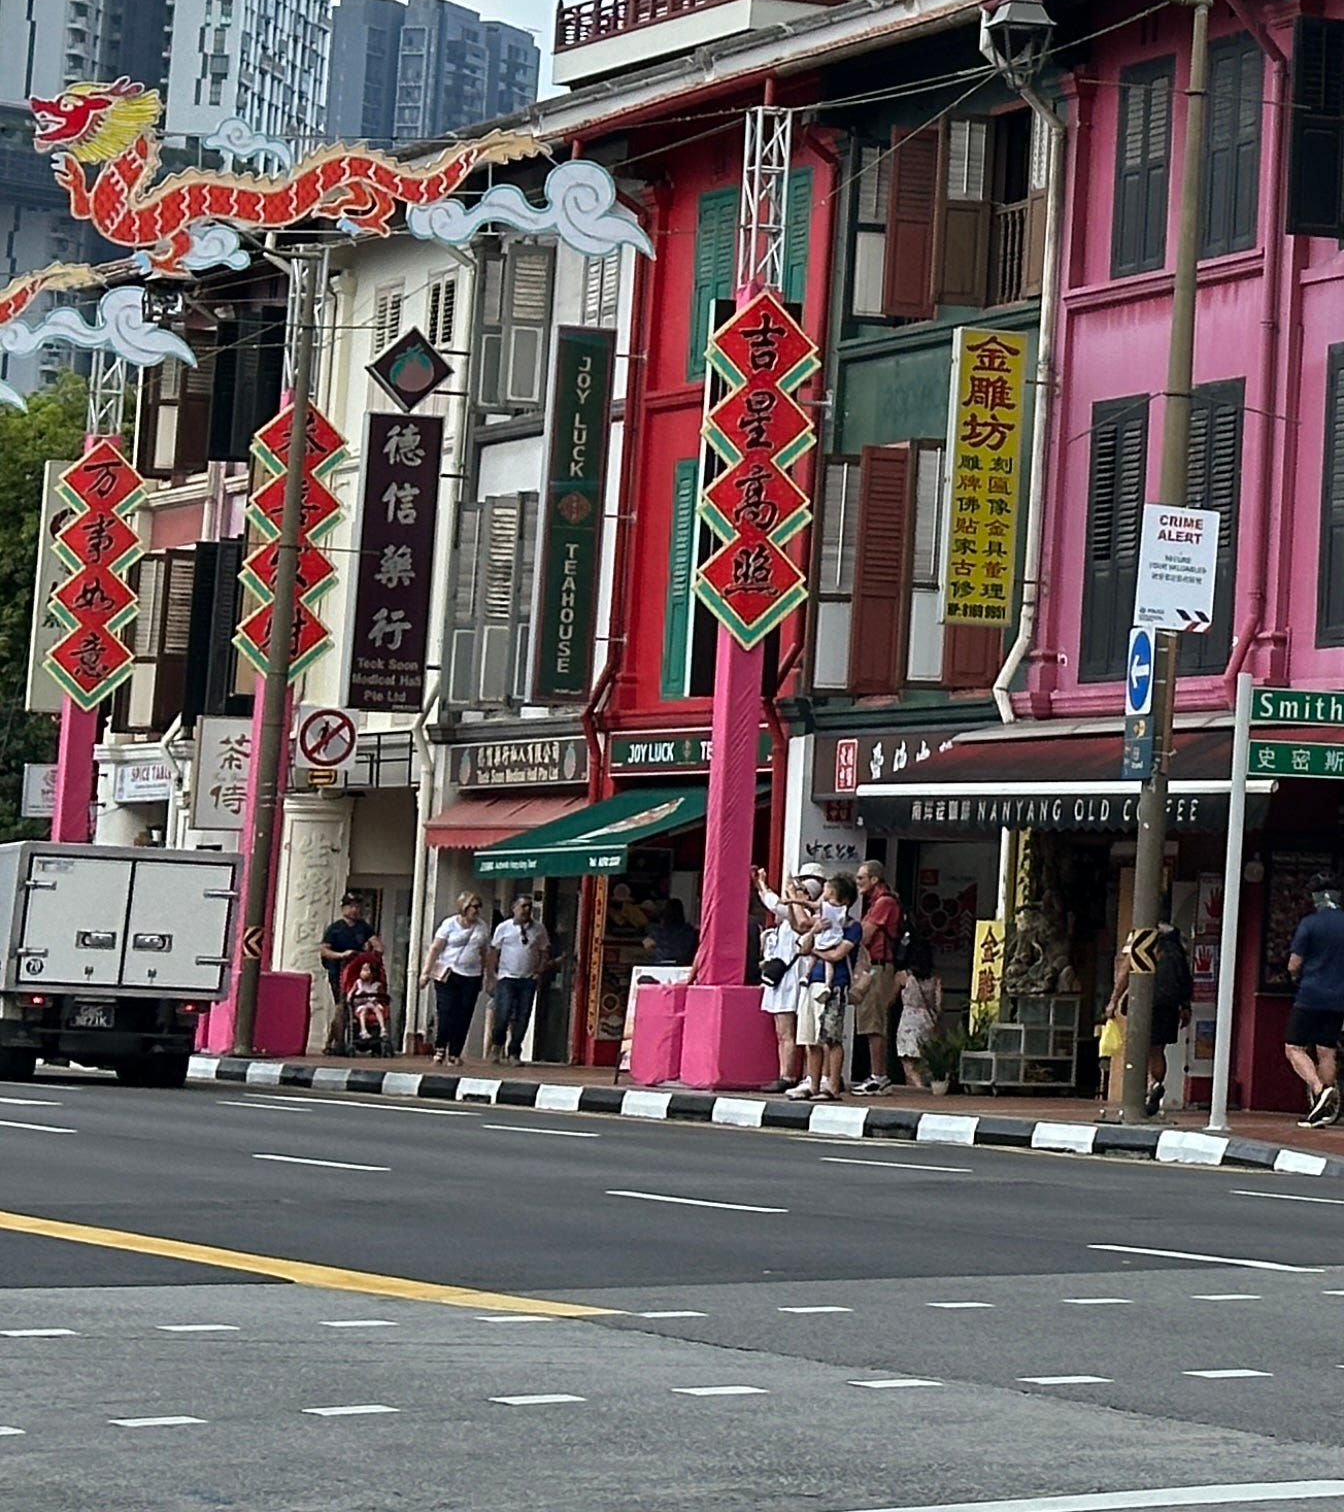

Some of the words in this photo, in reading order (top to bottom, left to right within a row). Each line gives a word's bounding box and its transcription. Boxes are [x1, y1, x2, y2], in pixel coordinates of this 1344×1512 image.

[576, 356, 592, 405] JOY
[961, 335, 1021, 451] 金雕坊
[569, 413, 587, 477] LUCK
[724, 311, 788, 598] 吉星高照
[1157, 530, 1203, 545] ALERT
[1160, 515, 1204, 530] CRIME
[557, 543, 579, 674] TEAHOUSE
[1260, 692, 1344, 722] Smith
[628, 744, 647, 763] JOY
[649, 742, 674, 762] LUCK
[977, 799, 1061, 821] NANYANG
[1074, 799, 1109, 821] OLD
[1123, 799, 1199, 821] CEE
